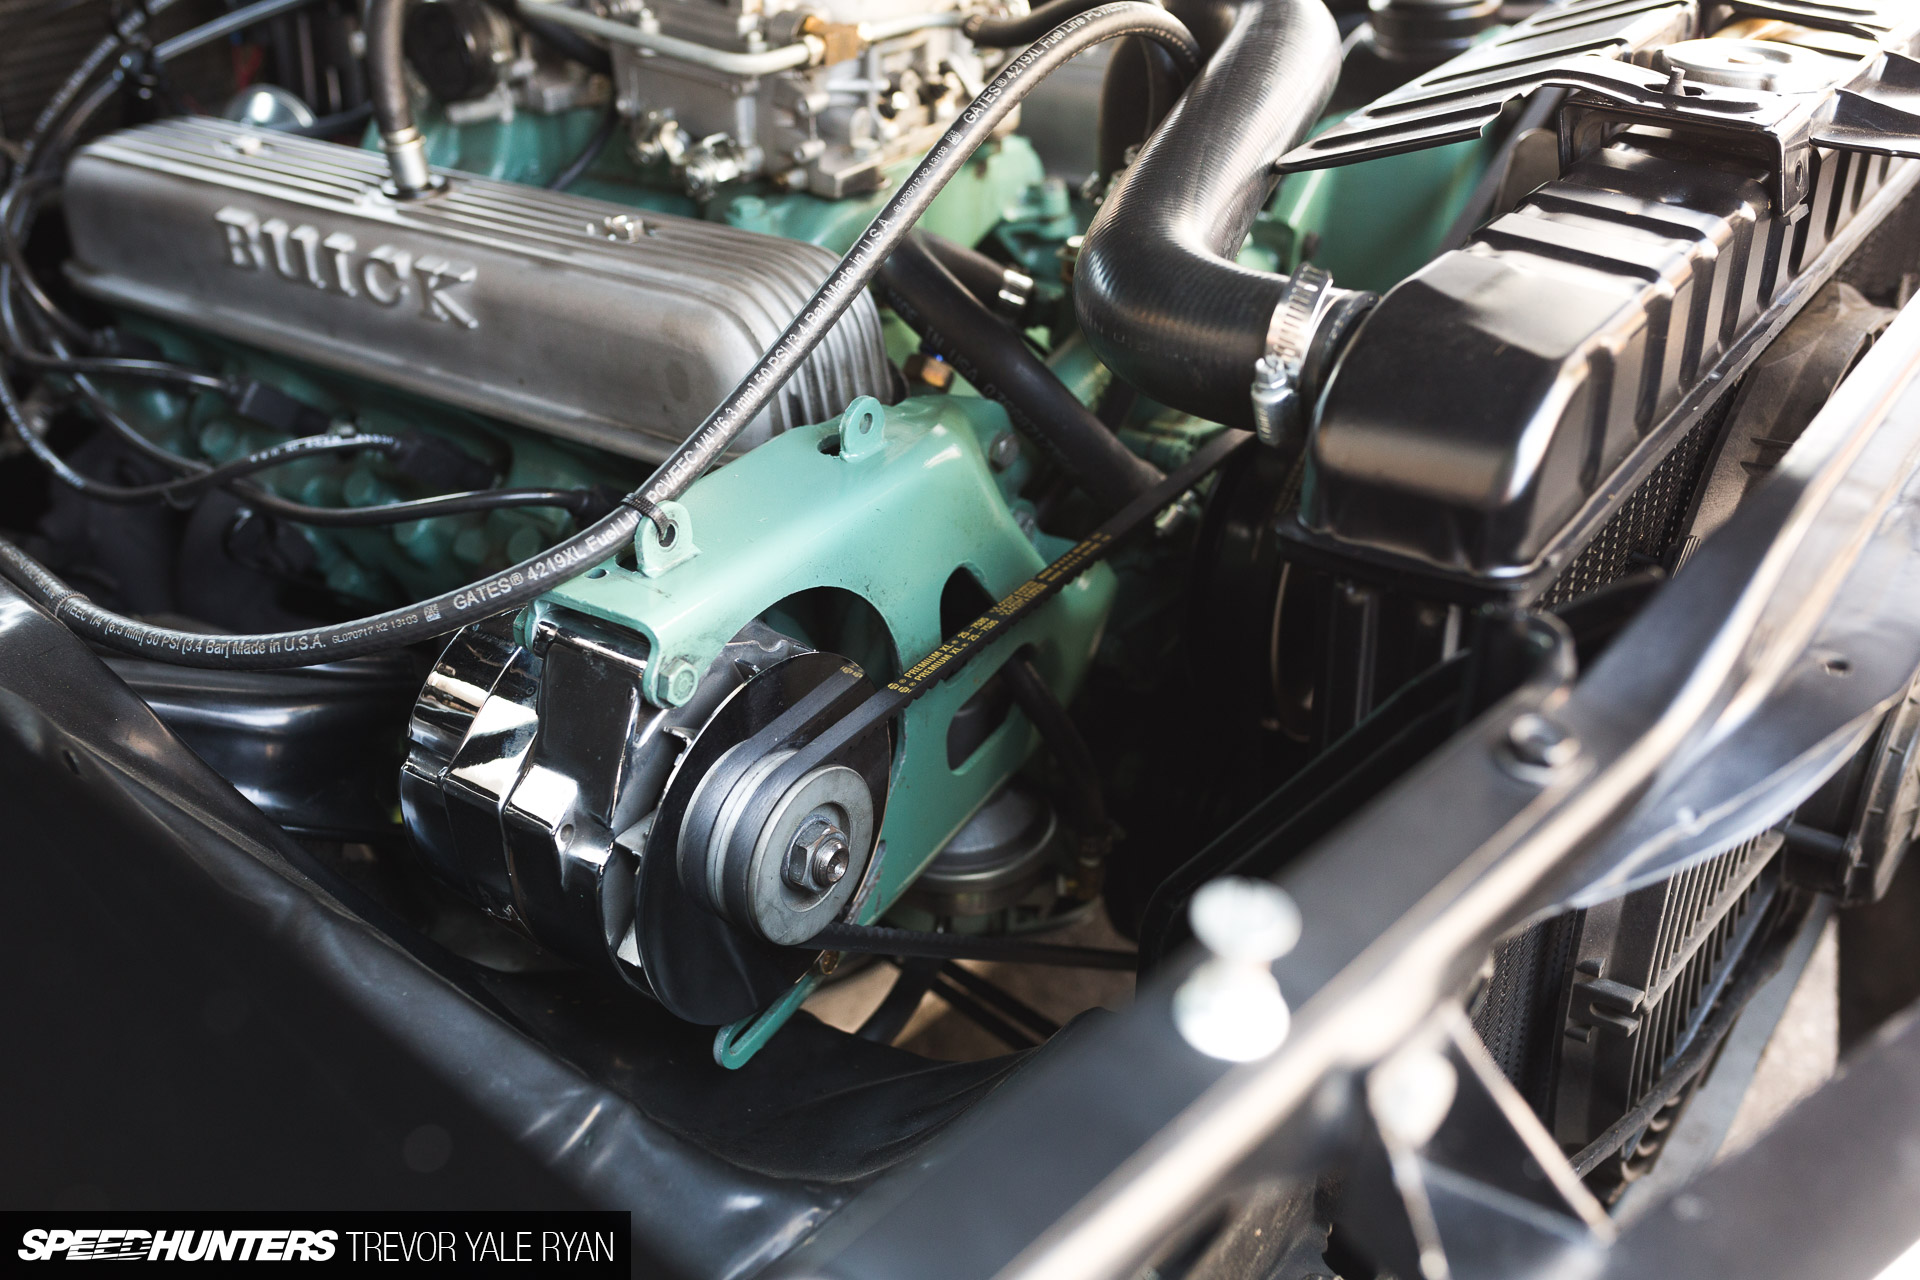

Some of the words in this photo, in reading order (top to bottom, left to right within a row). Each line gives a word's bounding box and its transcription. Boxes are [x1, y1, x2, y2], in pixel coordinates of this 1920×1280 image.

[215, 206, 479, 329] BUICK
[646, 450, 698, 504] PCV/EEC
[694, 427, 716, 453] 1/4"
[754, 368, 773, 385] 50
[768, 344, 793, 371] PSI
[823, 267, 855, 300] Made
[849, 253, 864, 266] in
[859, 218, 895, 253] U.S.A.
[1005, 43, 1046, 80] 4219XL
[1042, 26, 1064, 50] Fuel
[1063, 17, 1086, 34] Line
[146, 632, 159, 646] 50
[161, 635, 181, 650] PSI
[232, 641, 266, 655] Made
[269, 639, 281, 654] in
[284, 634, 327, 652] U.S.A.
[391, 614, 419, 629] 13:03
[527, 545, 587, 582] 4219XL
[585, 518, 621, 553] Fuel
[617, 509, 643, 532] Lin
[904, 651, 943, 678] PREMIUM
[914, 654, 952, 681] PREMIUM
